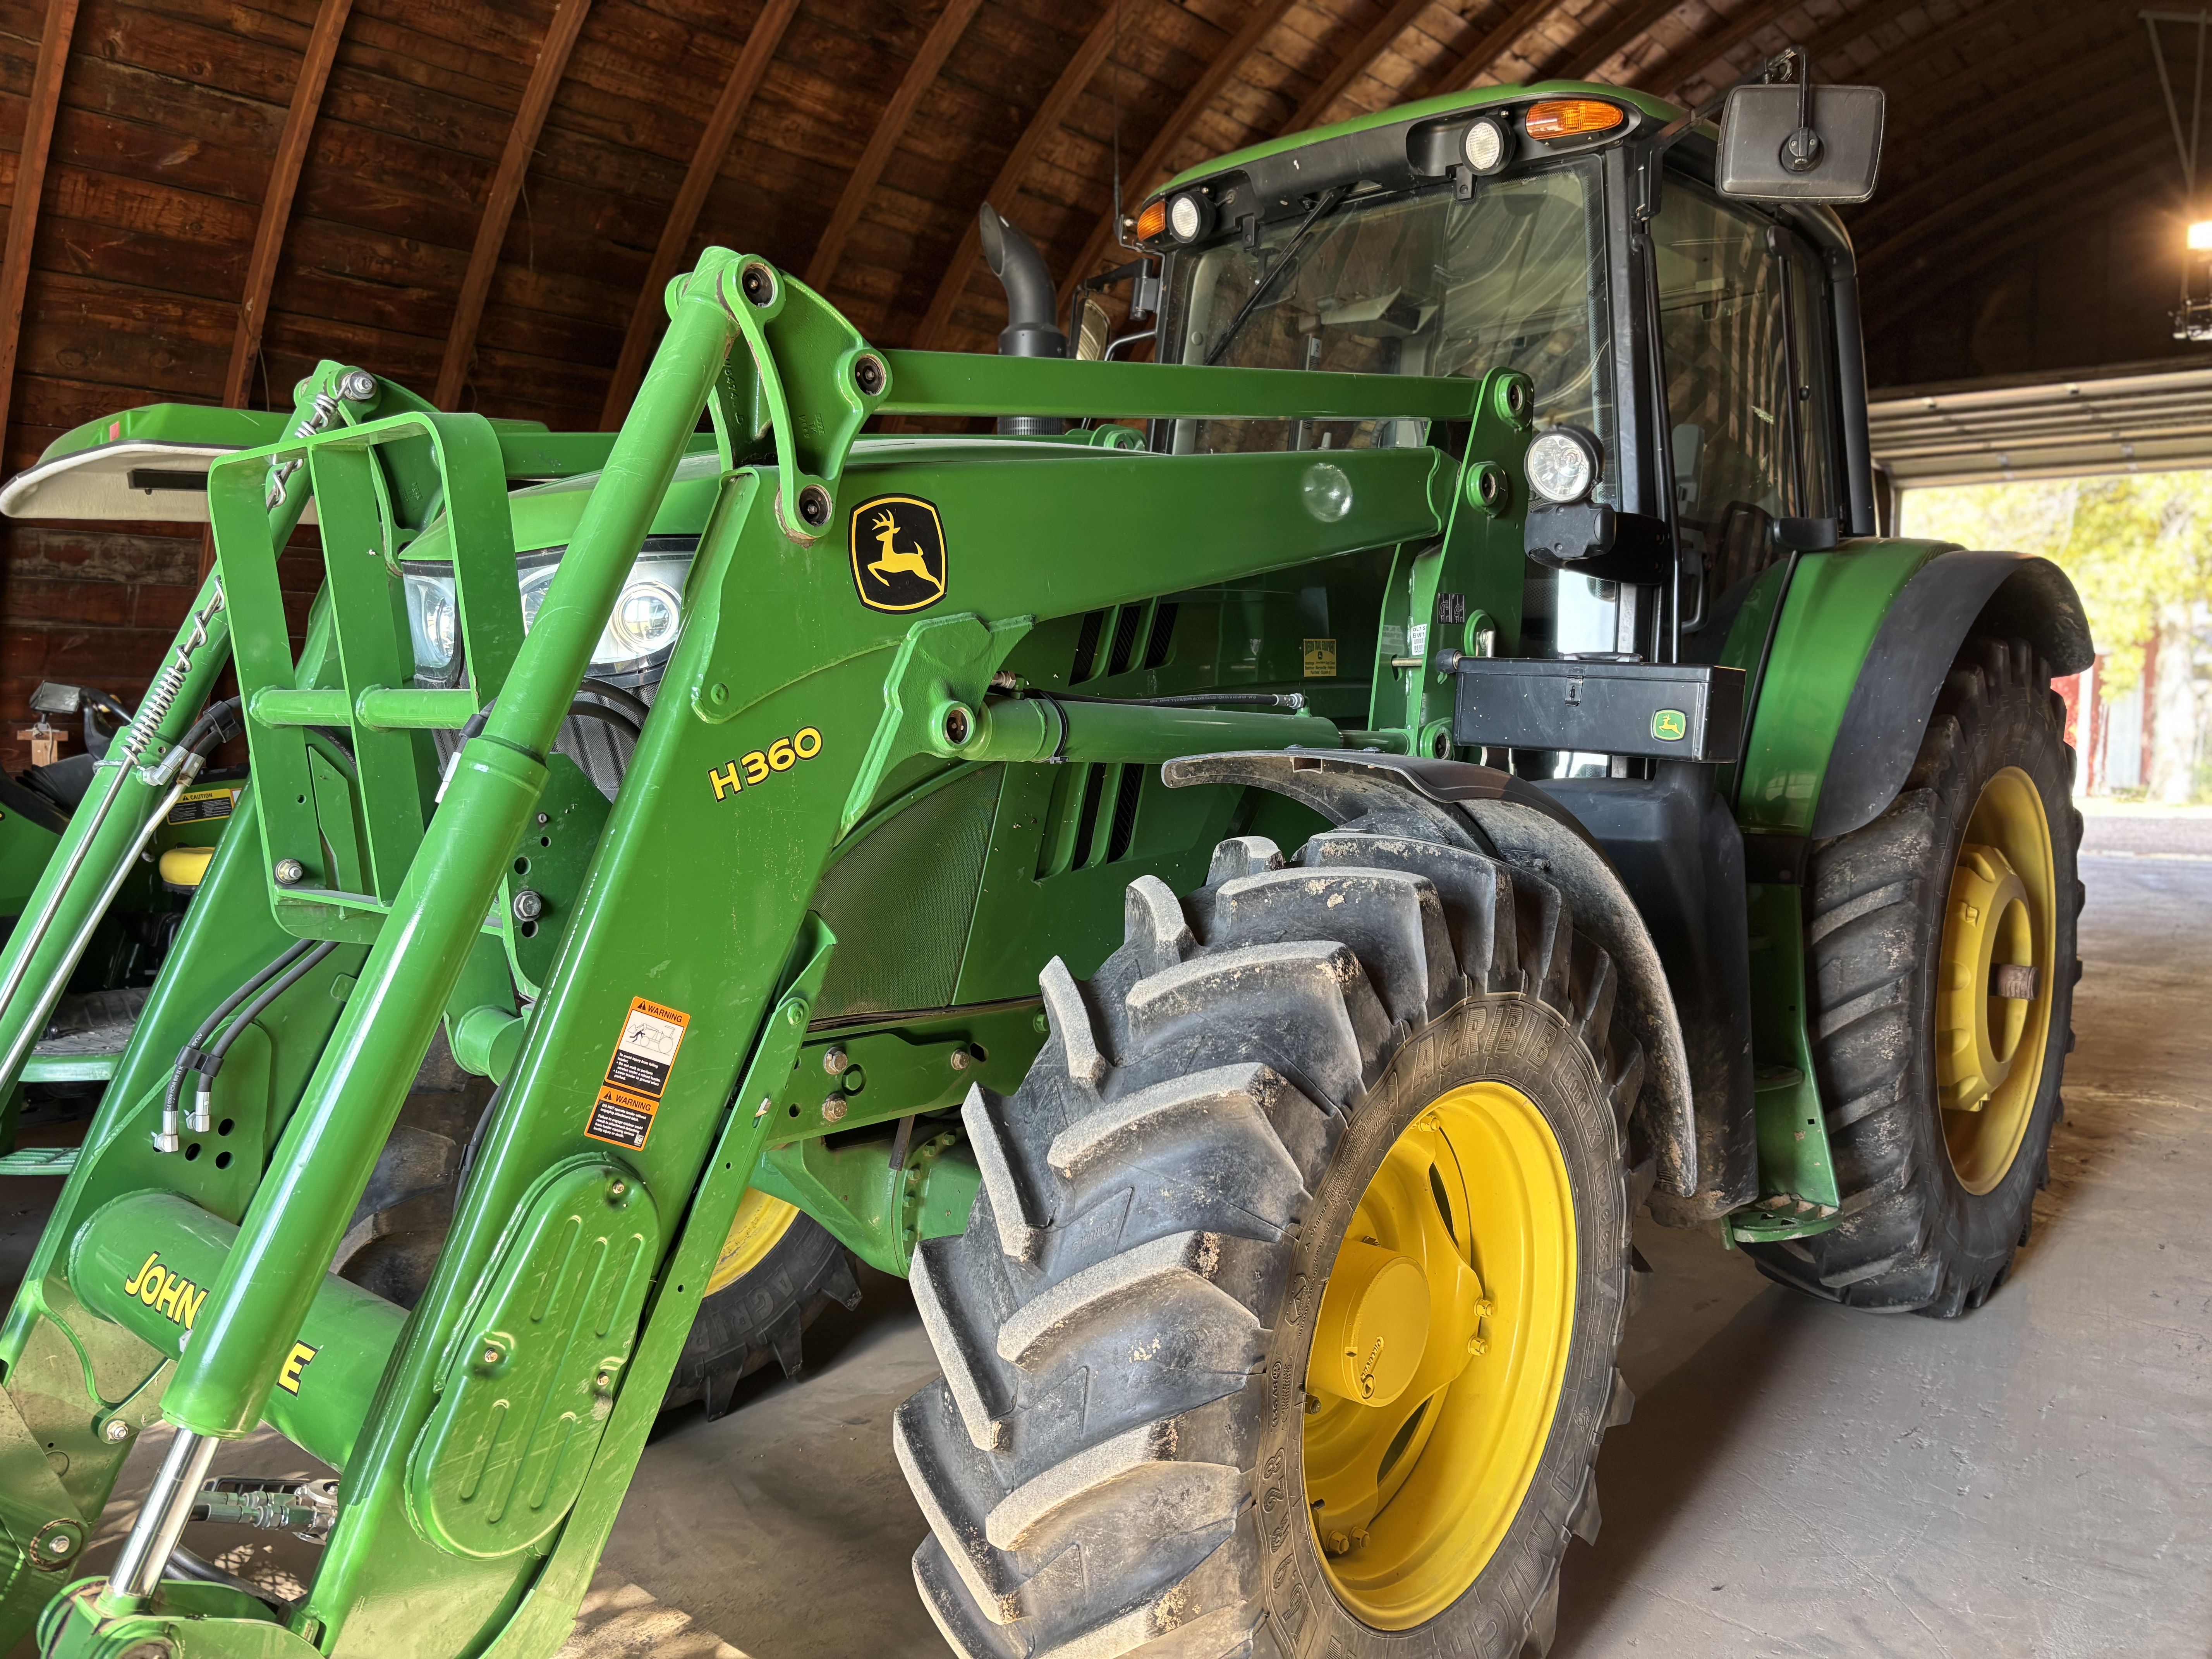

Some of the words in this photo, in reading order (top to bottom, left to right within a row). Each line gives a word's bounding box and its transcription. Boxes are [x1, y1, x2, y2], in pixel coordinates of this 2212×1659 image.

[708, 726, 823, 802] H360
[648, 1005, 682, 1023] WARNING
[1412, 1004, 1559, 1093] AGRIBIB
[616, 1094, 651, 1111] WARNING
[1565, 1072, 1592, 1118] radial
[1586, 1118, 1602, 1147] X
[1595, 1167, 1609, 1266] tubeless
[124, 1251, 210, 1331] JOHN
[689, 1264, 795, 1354] AGRIB
